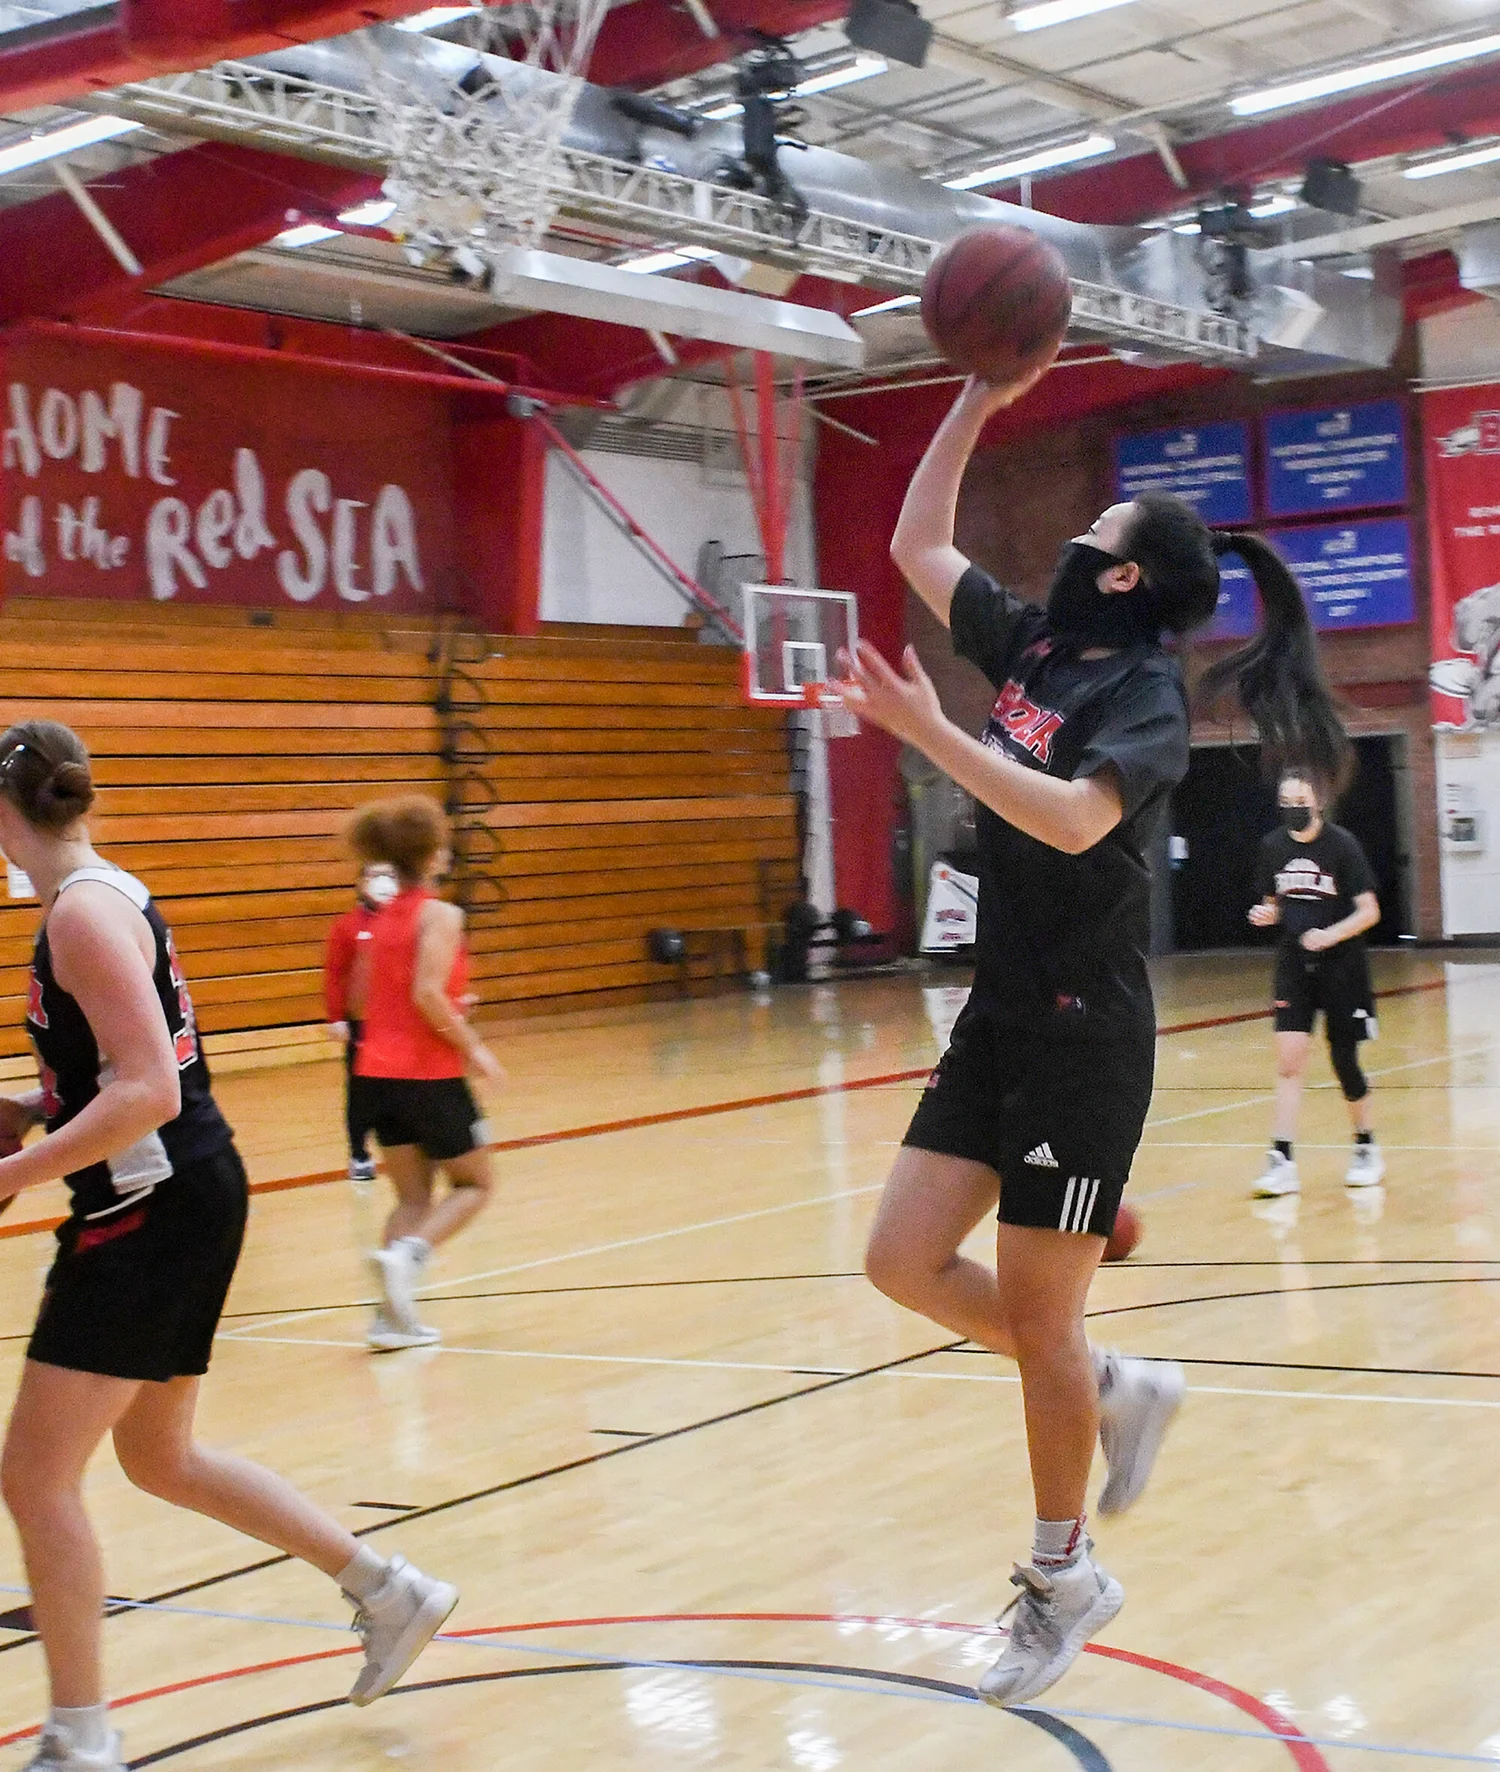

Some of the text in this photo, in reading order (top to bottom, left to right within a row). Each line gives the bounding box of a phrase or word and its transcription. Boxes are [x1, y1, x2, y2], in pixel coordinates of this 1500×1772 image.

[54, 496, 129, 570] the
[146, 448, 277, 600] Red
[277, 468, 424, 601] SEA
